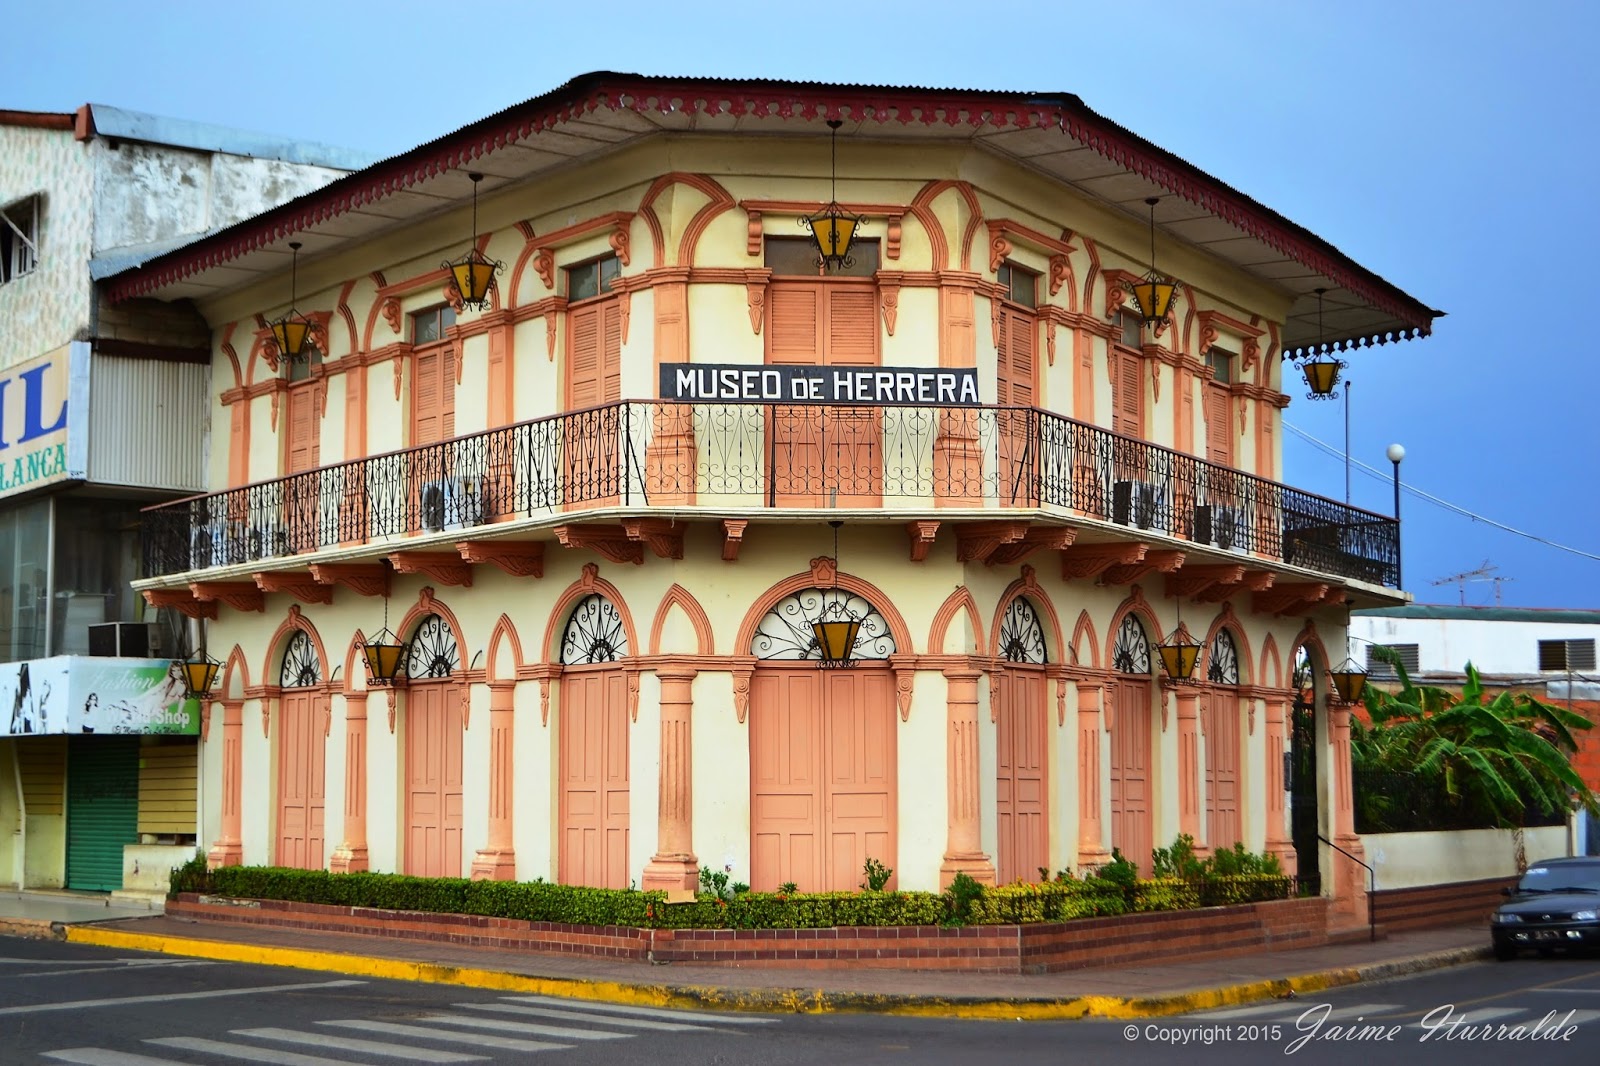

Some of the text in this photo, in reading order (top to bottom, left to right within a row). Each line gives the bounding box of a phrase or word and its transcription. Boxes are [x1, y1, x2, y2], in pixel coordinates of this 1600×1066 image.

[676, 368, 978, 403] MUSEO DE HERRERA
[156, 708, 190, 728] Shop
